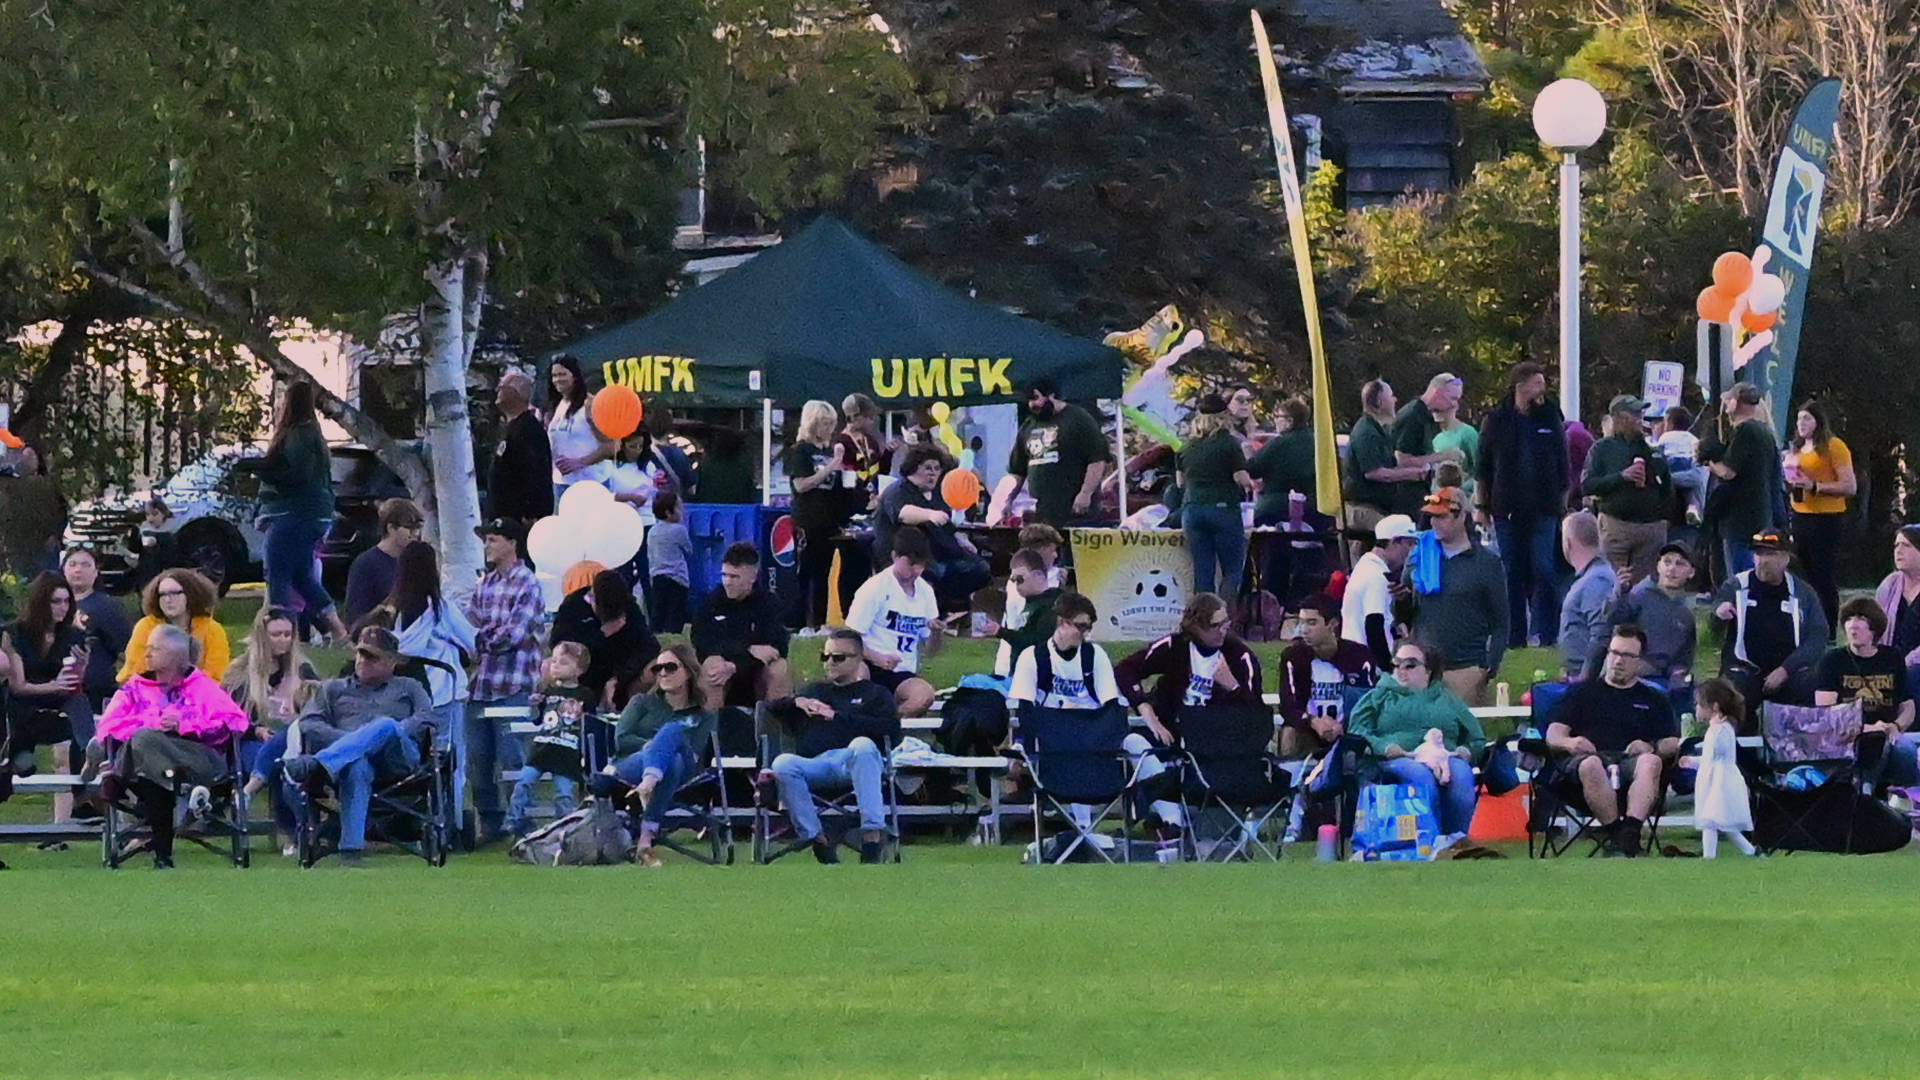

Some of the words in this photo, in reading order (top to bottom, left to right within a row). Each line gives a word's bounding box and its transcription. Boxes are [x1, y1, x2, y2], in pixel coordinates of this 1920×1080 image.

[602, 355, 696, 393] UMFK
[871, 358, 1014, 398] UMFK
[1659, 369, 1672, 381] NO
[1072, 529, 1113, 550] Sign
